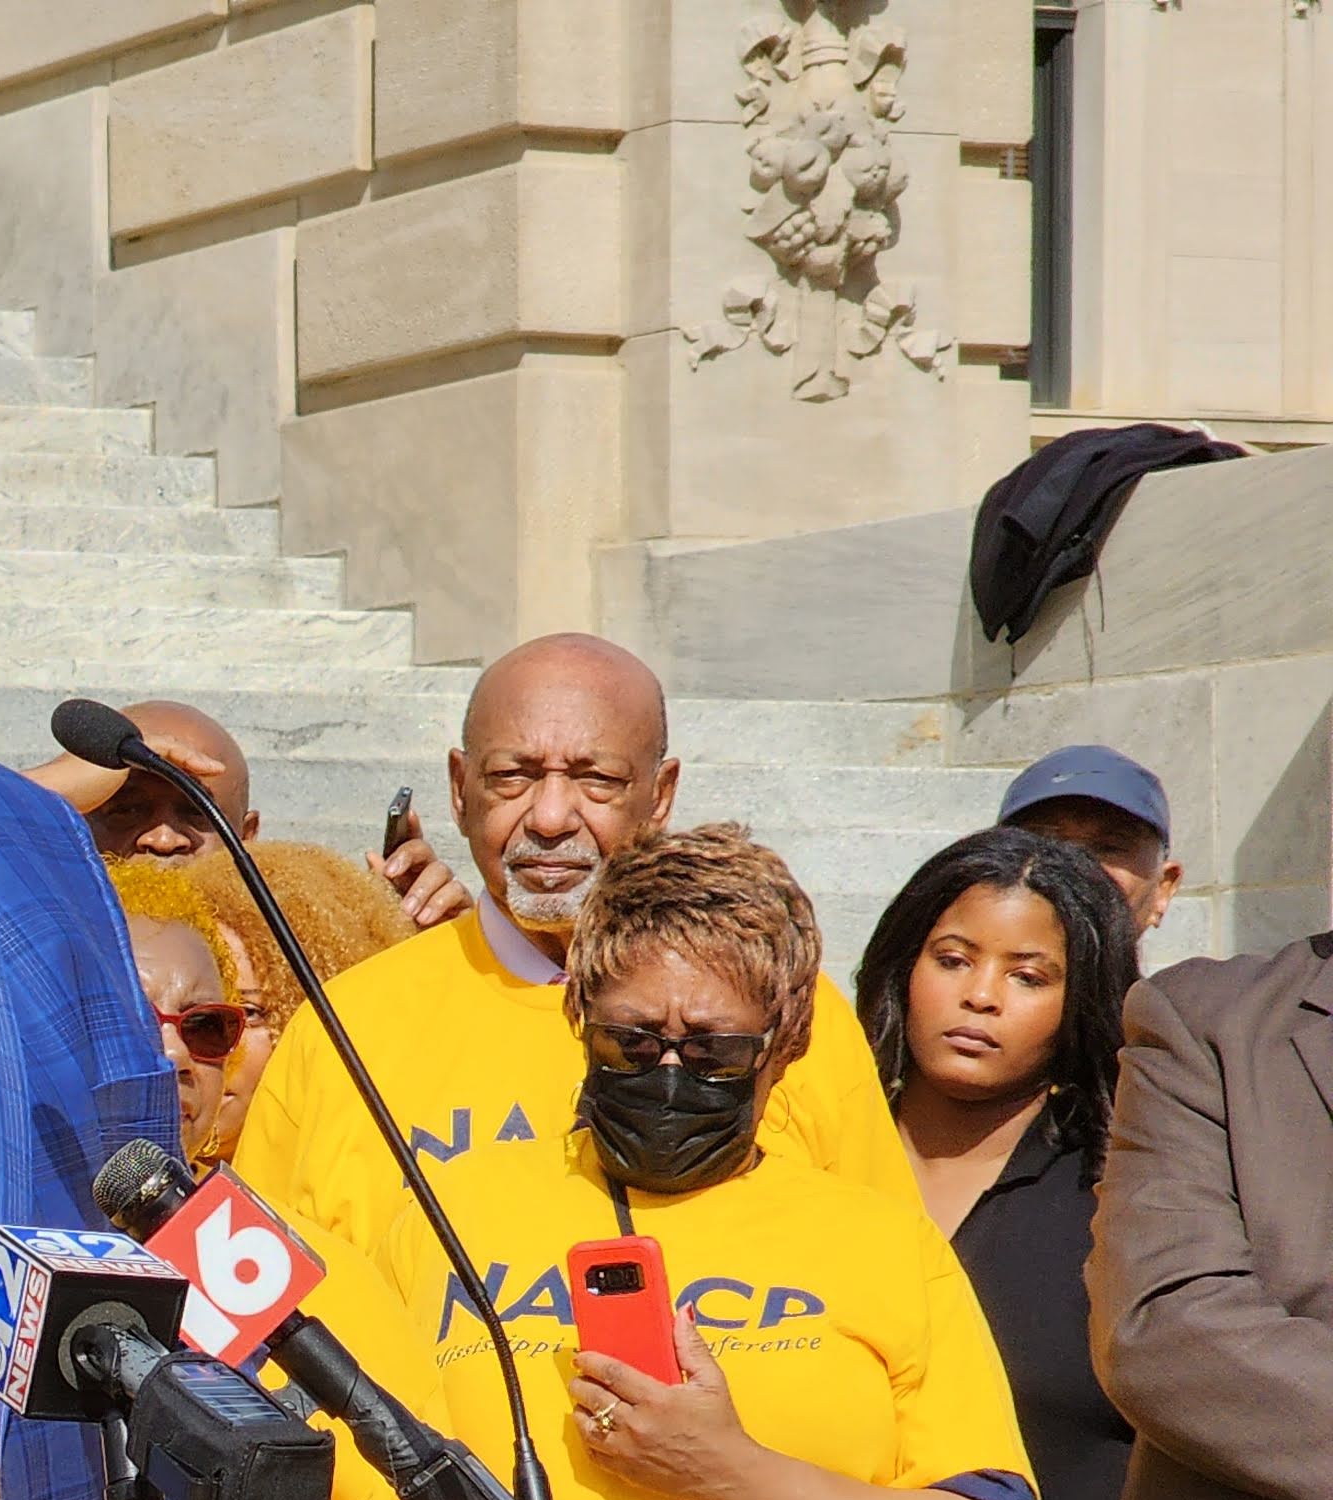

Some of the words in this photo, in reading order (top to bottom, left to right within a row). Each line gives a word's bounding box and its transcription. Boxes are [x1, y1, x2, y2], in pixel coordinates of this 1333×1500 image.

[47, 1256, 175, 1277] NEWS
[437, 1262, 826, 1344] NACP
[6, 1269, 48, 1406] NEWS
[707, 1335, 822, 1358] nference
